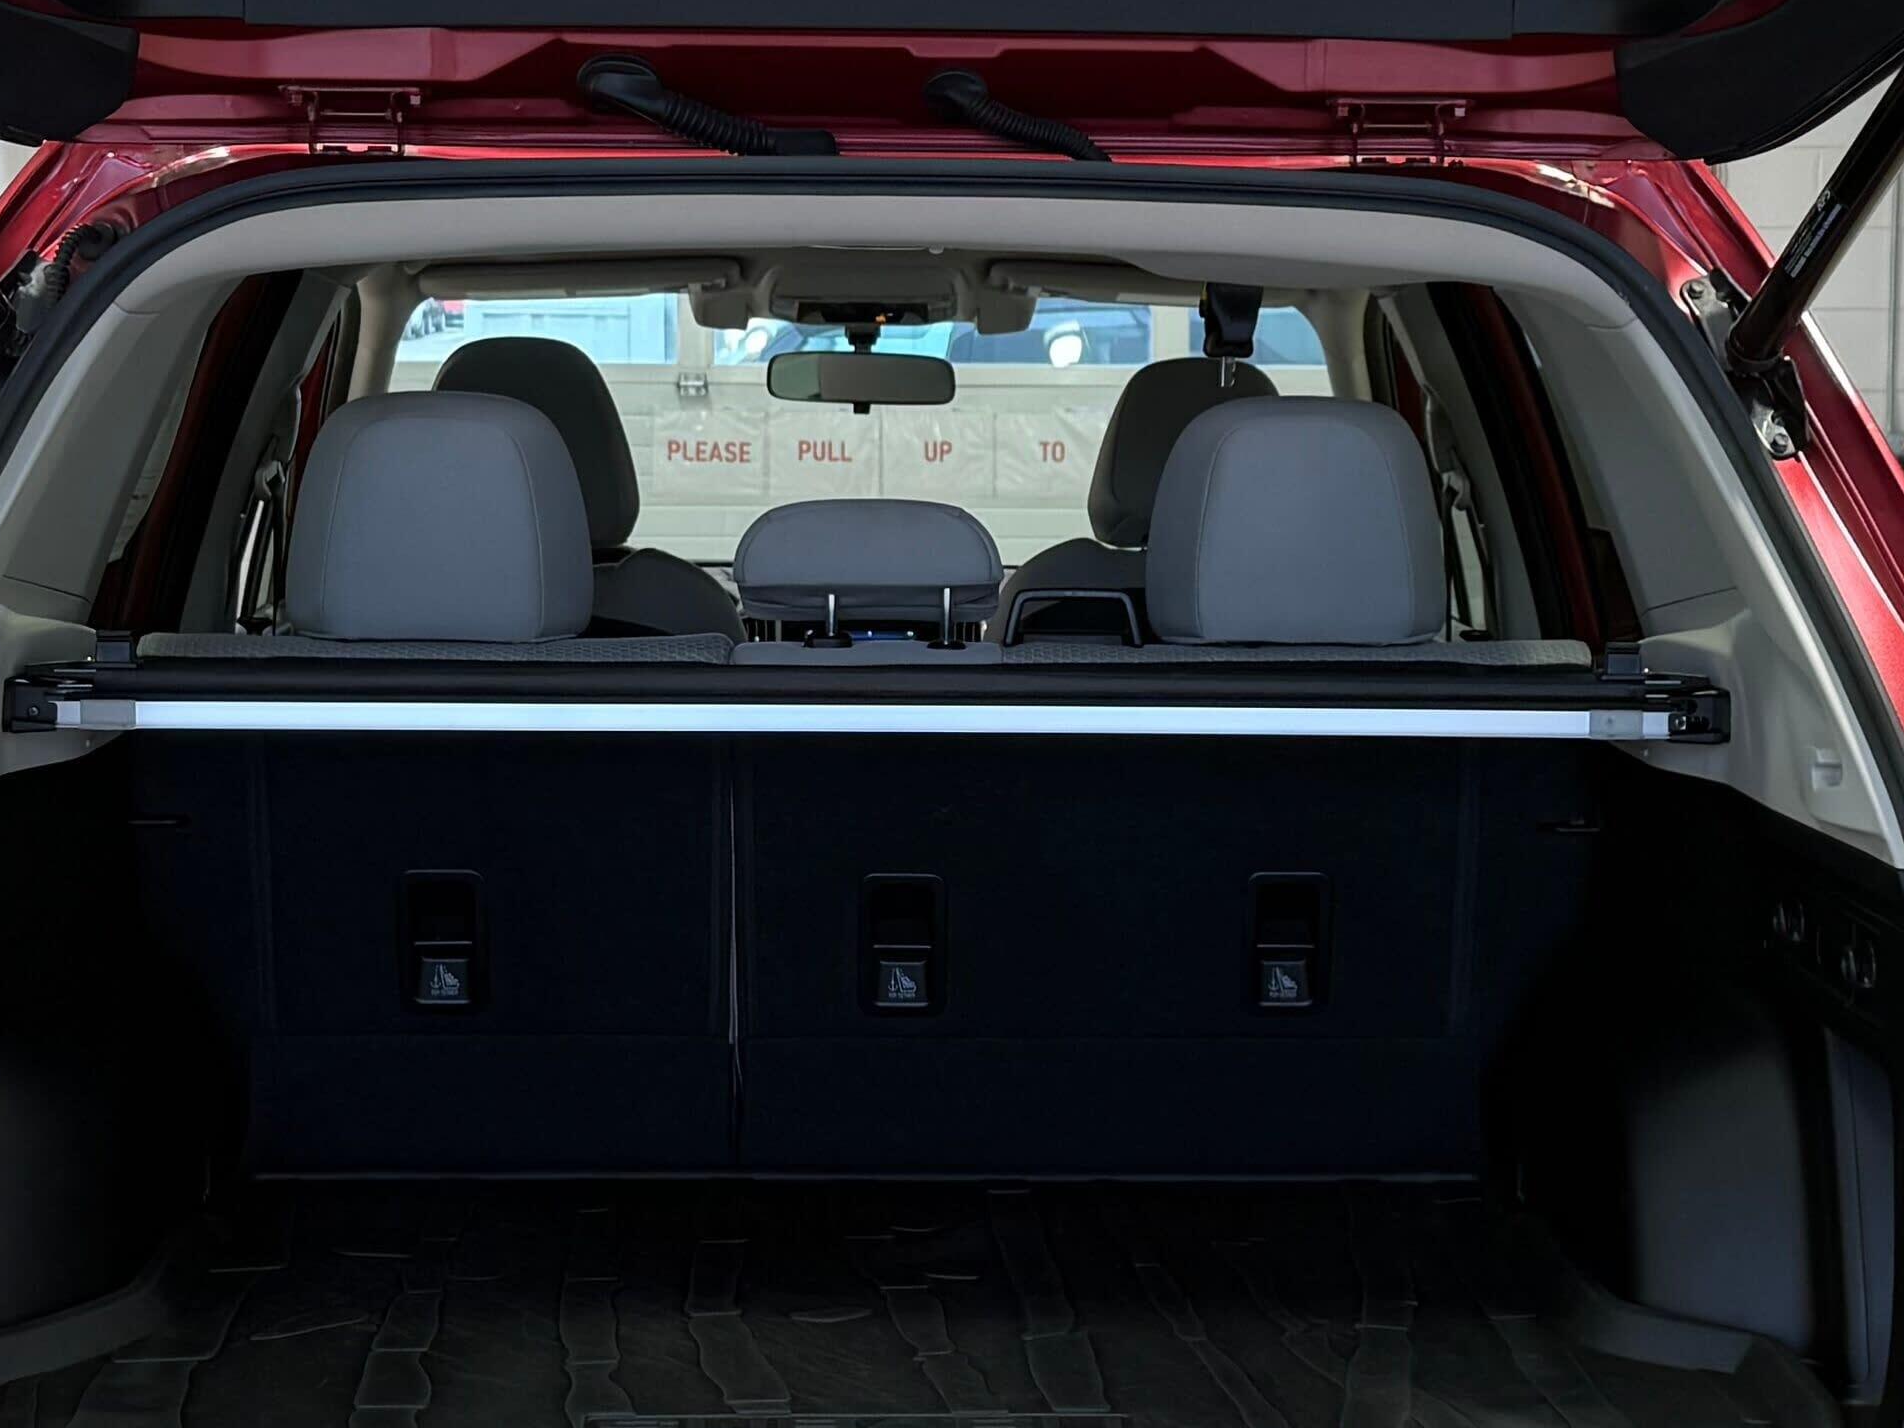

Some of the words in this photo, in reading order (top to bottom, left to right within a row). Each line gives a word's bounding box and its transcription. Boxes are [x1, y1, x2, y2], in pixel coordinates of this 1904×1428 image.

[666, 440, 752, 464] PLEASE
[797, 440, 853, 464] PULL
[923, 441, 953, 463] UP
[1039, 441, 1066, 463] TO
